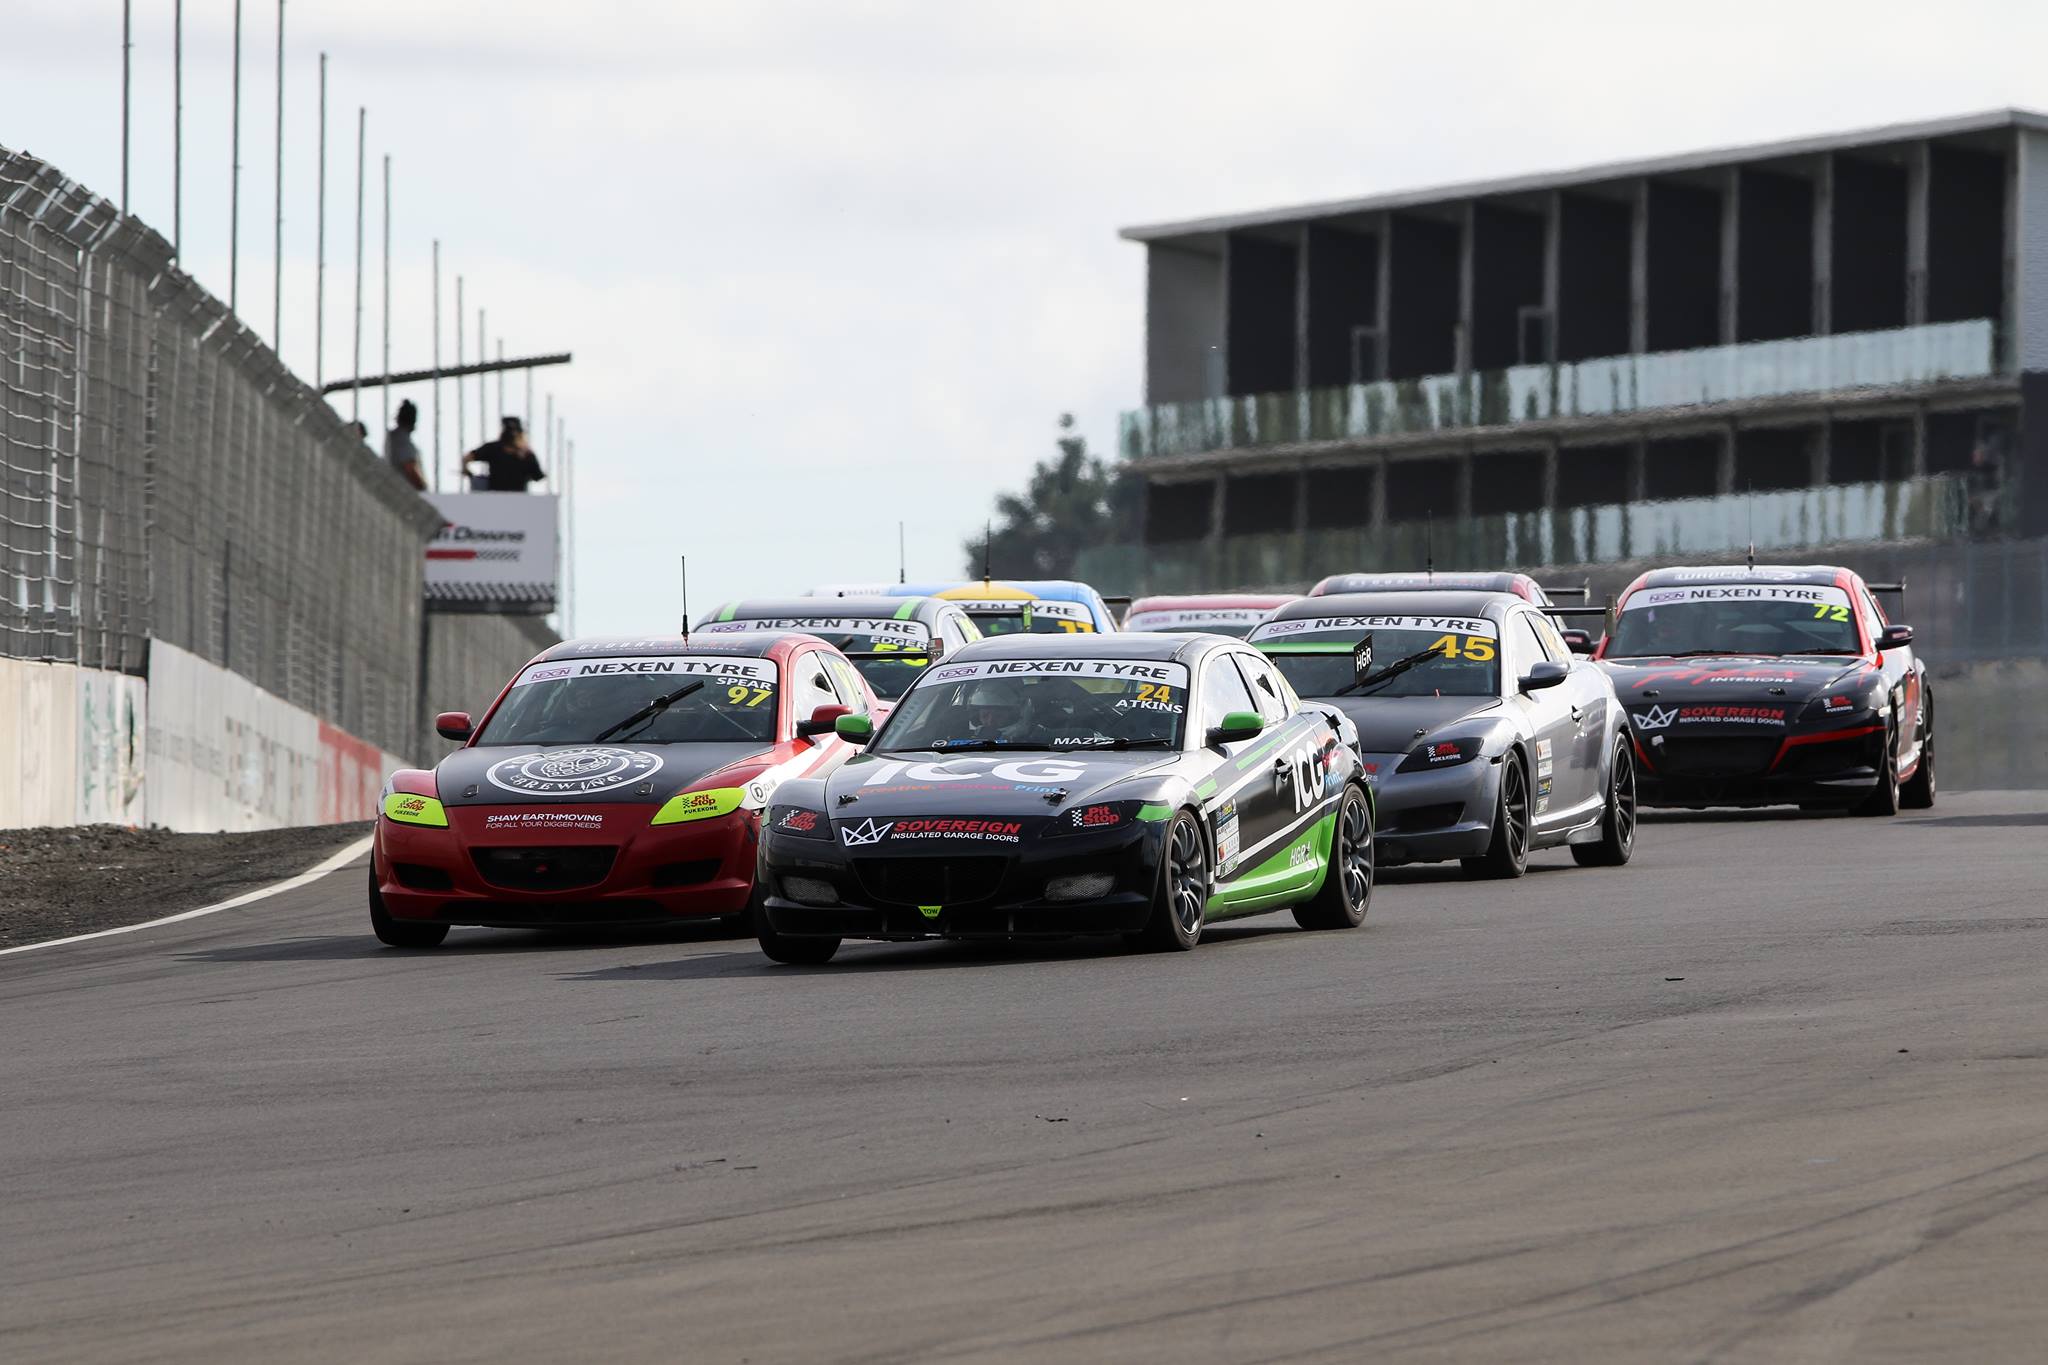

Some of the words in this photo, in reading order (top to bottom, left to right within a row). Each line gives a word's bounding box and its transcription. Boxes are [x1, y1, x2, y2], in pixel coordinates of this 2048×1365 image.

[1690, 588, 1761, 600] NEXEN
[1768, 588, 1823, 601] TYRE
[1813, 603, 1849, 622] 72
[755, 618, 842, 630] NEXEN
[852, 620, 917, 635] TYRE
[1314, 616, 1401, 629] NEXEN
[1408, 617, 1482, 632] TYRE
[1427, 634, 1495, 661] 45
[1356, 647, 1372, 672] HGR
[579, 661, 675, 674] NEXEN
[684, 662, 759, 677] TYRE
[987, 661, 1083, 674] NEXEN
[1093, 662, 1169, 679] TYRE
[715, 677, 772, 691] SPEAR
[727, 686, 774, 707] 97
[1136, 684, 1171, 702] 24
[1115, 699, 1183, 714] ATKINS
[1679, 706, 1785, 718] SOVEREIGN
[1679, 716, 1721, 724] INSULATED
[1723, 716, 1756, 724] GARAGE
[1757, 717, 1785, 726] DOORS
[863, 757, 1088, 786] ICG
[690, 799, 716, 807] Stop
[487, 814, 521, 823] SHAW
[522, 813, 603, 822] EARTHMOVING
[1088, 806, 1110, 816] Pit
[574, 821, 601, 829] NEEDS
[894, 819, 1021, 835] SOVEREIGN
[1083, 814, 1119, 825] Stop
[891, 831, 940, 840] INSULATED
[943, 831, 983, 840] GARAGE
[985, 834, 1020, 843] DOORS
